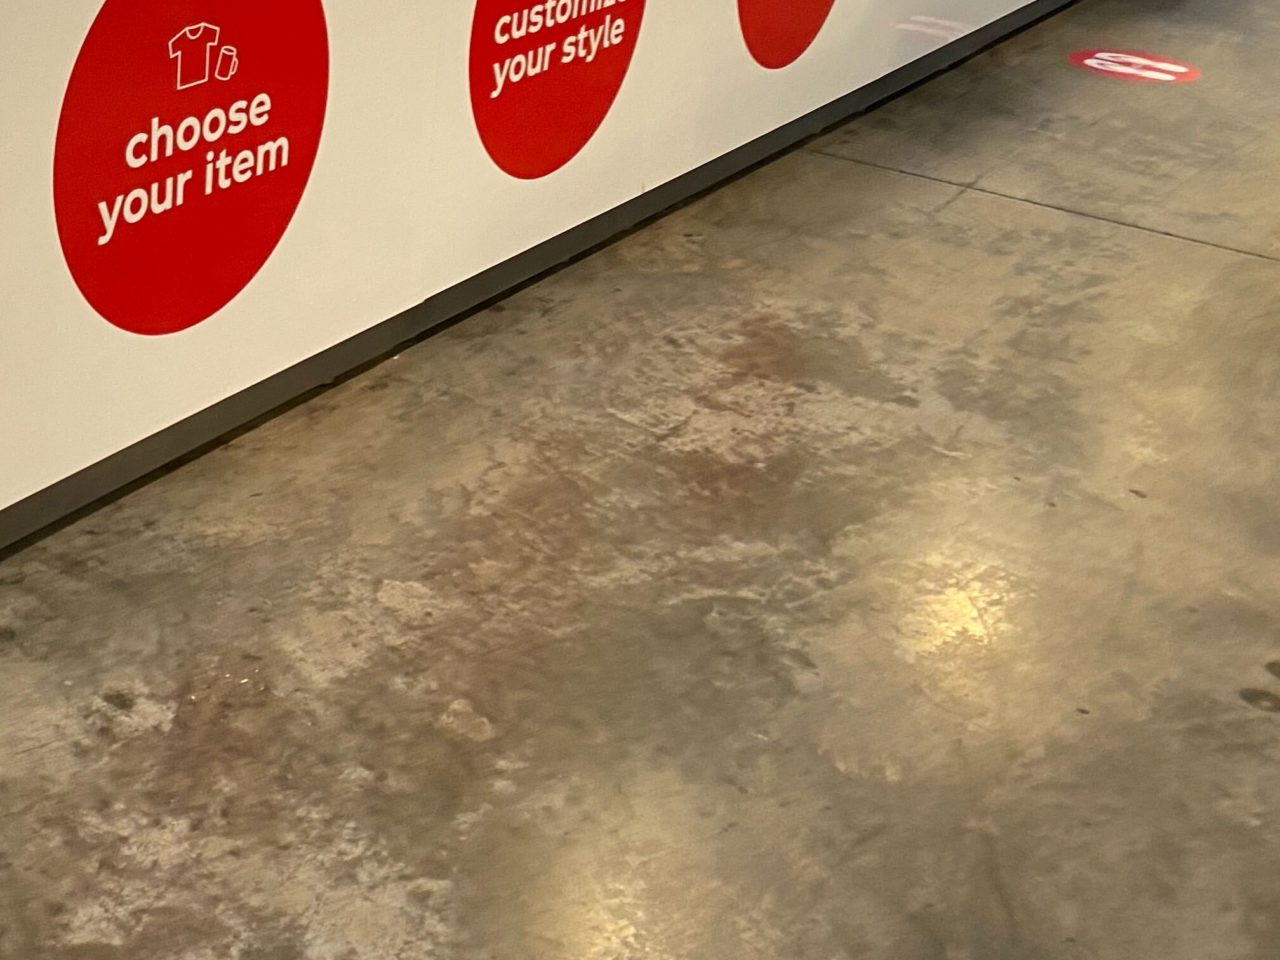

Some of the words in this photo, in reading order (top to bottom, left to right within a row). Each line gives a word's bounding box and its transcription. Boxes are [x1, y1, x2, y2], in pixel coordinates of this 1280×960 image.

[490, 42, 556, 99] your
[561, 14, 625, 63] style
[125, 93, 271, 168] choose
[97, 170, 193, 246] your
[204, 136, 289, 195] item
